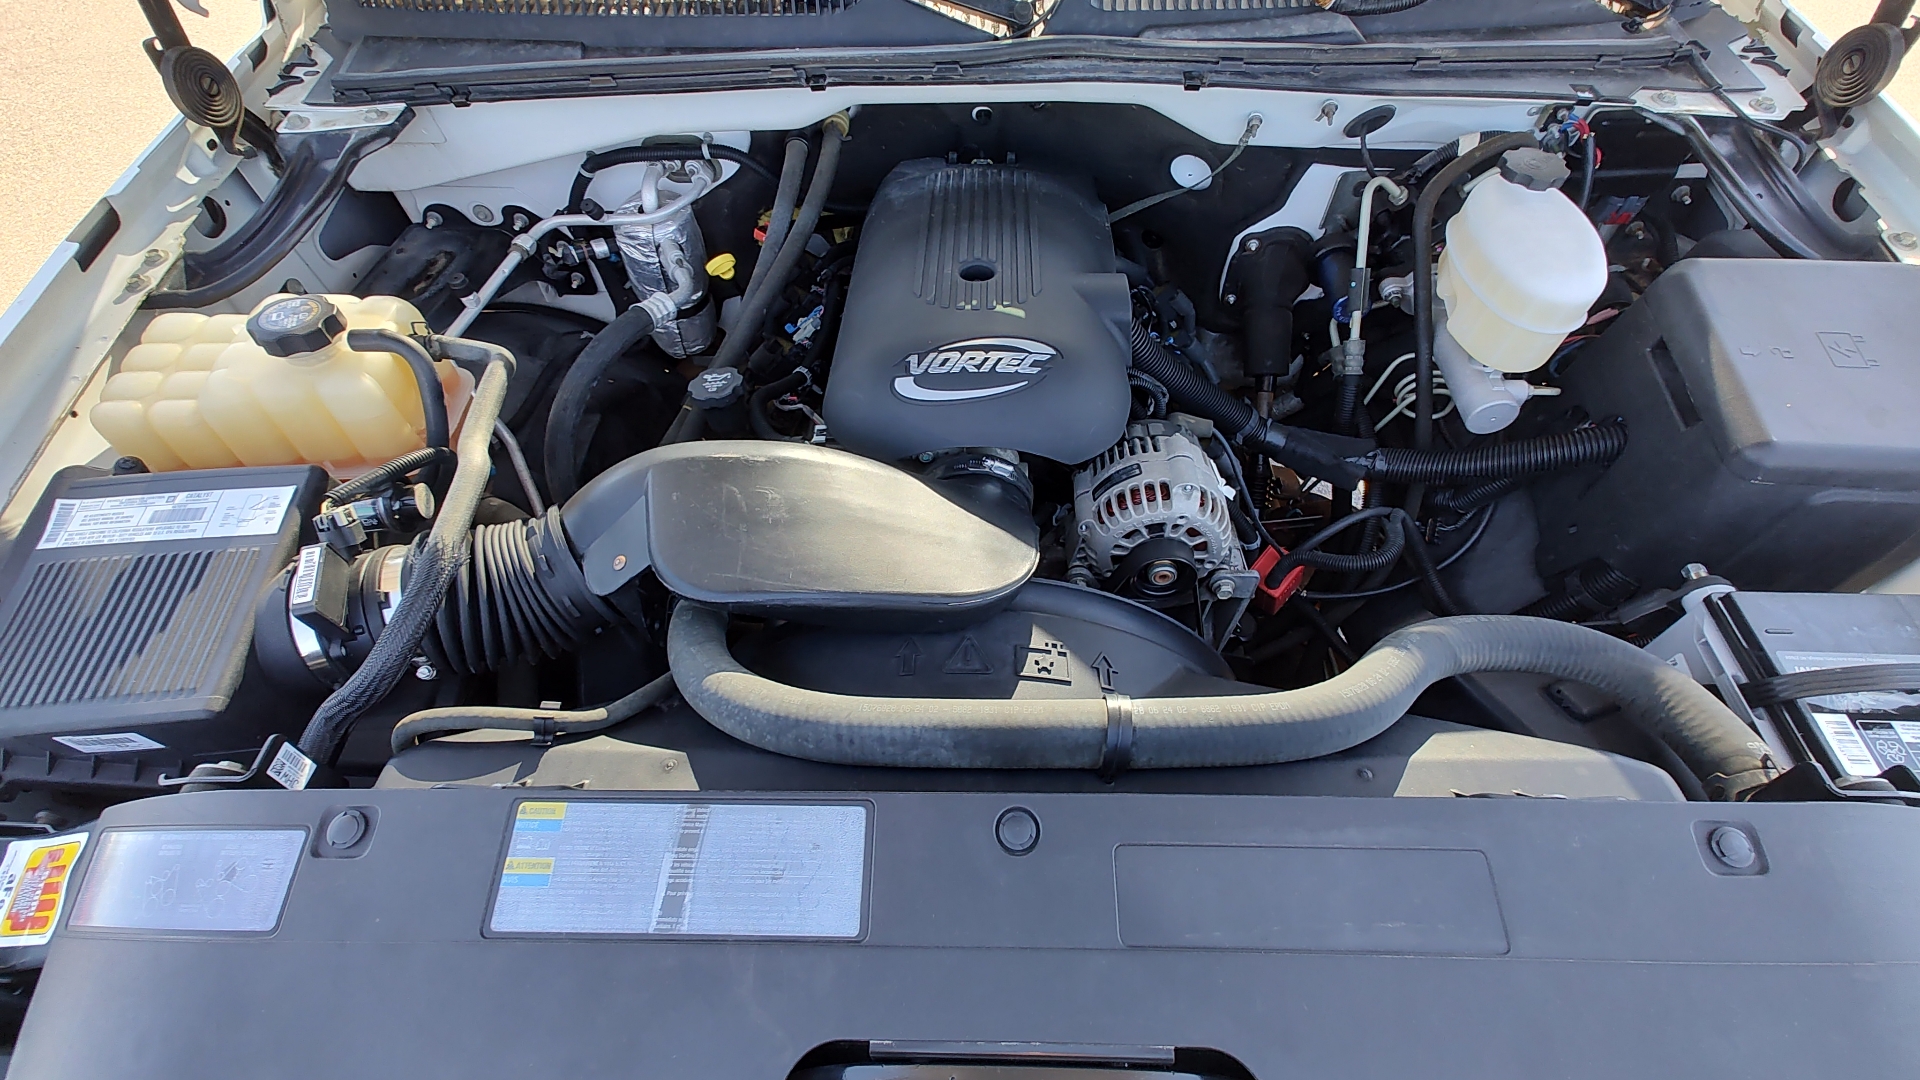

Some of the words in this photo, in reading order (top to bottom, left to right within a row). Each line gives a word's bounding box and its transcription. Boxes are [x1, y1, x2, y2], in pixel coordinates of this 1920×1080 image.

[904, 350, 1052, 375] VORTEC
[529, 807, 557, 815] CAUTION
[516, 862, 552, 870] ATTENTION
